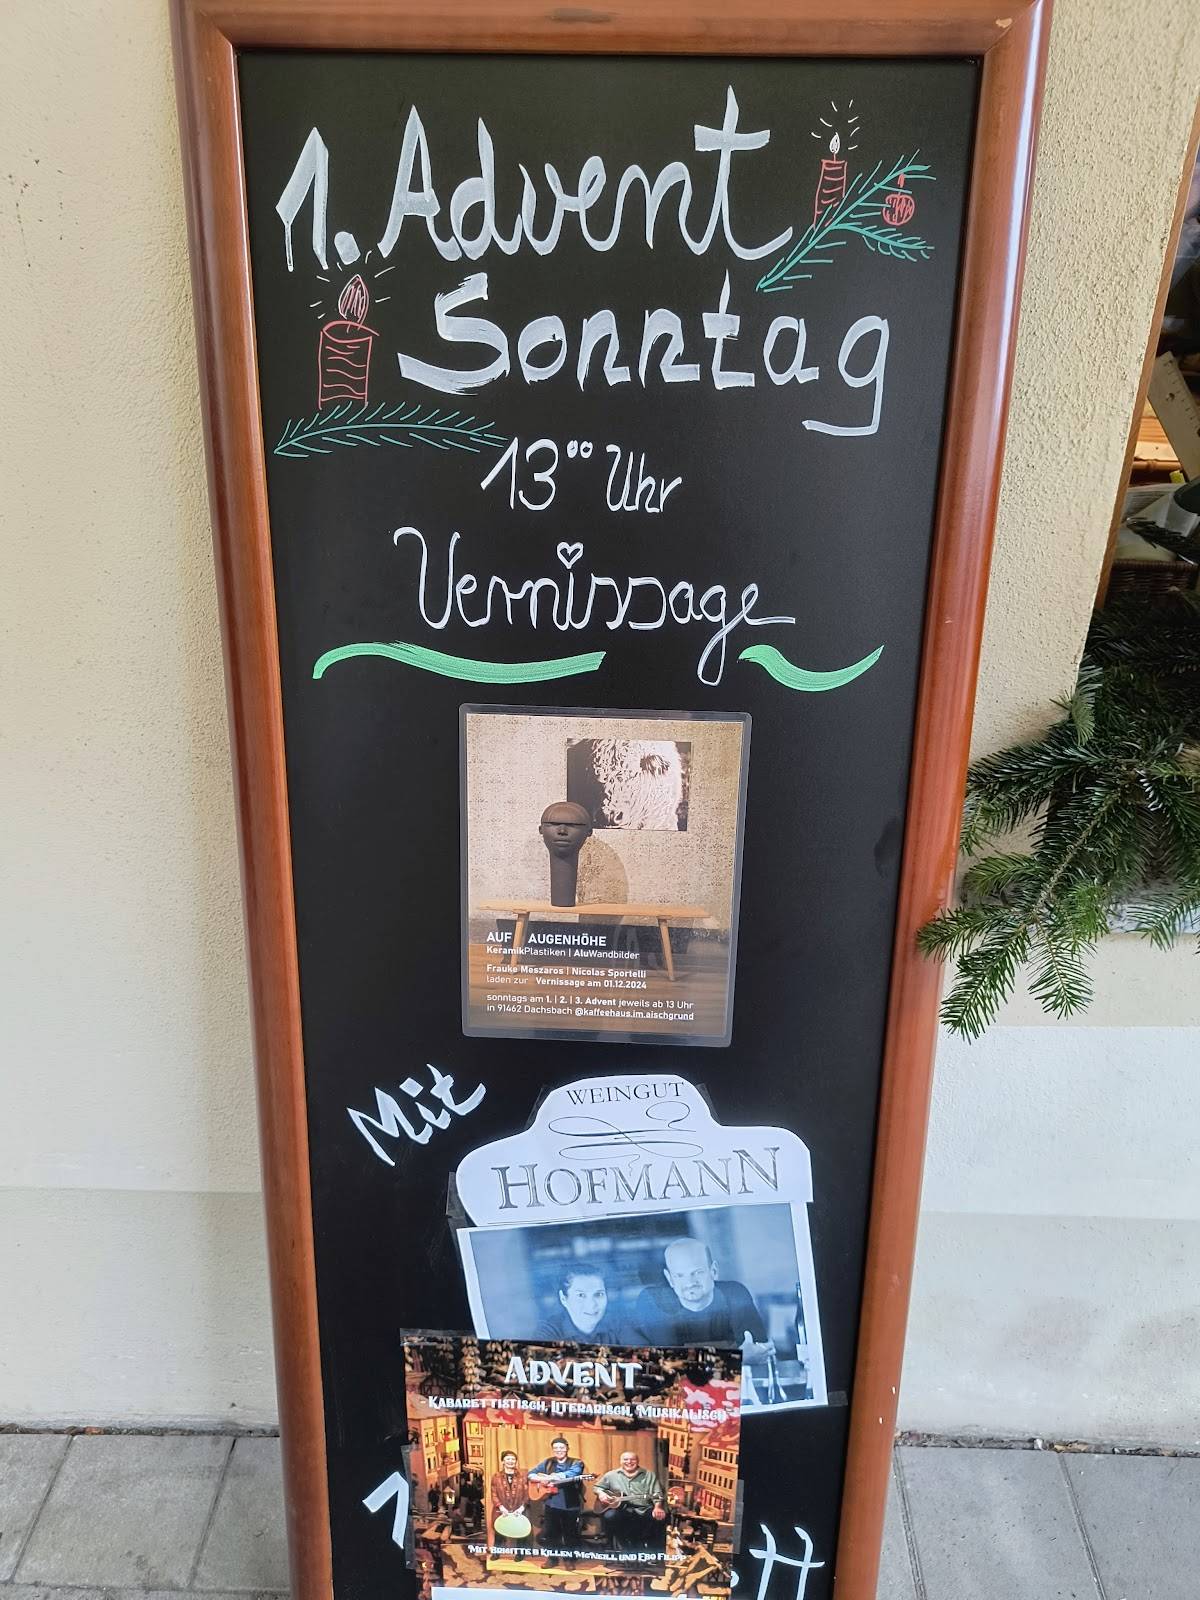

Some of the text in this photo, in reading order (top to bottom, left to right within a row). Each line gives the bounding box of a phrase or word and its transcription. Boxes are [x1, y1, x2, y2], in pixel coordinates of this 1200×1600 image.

[275, 85, 793, 271] 1. Advent
[397, 269, 890, 436] Sonntag
[605, 444, 683, 513] Uhr
[393, 527, 796, 687] Vernissage
[486, 932, 607, 947] AUF AUGENHÖHE
[486, 945, 566, 957] KeramikPlastiken
[573, 948, 640, 959] AluWandbilder
[486, 964, 518, 973] Frauke
[520, 965, 564, 975] Meszaros
[571, 967, 606, 977] Nicolas
[607, 968, 647, 979] Sportelli
[486, 975, 511, 984] laden
[513, 977, 528, 985] zur
[535, 977, 586, 988] Vernissage
[603, 979, 647, 990] 01.12.2024
[486, 994, 528, 1004] sonntags
[529, 995, 544, 1003] am
[545, 995, 553, 1003] 1.
[559, 995, 568, 1004] 2.
[574, 996, 583, 1005] 3.
[584, 997, 616, 1006] Advent
[617, 998, 650, 1008] jeweils
[652, 1000, 663, 1008] ab
[665, 1000, 675, 1009] 13
[676, 1000, 694, 1009] Uhr
[486, 1004, 694, 1021] in 91462 Dachsbach @kaffeehaus.im.aischgrund
[566, 1081, 685, 1107] WEINGUT
[347, 1063, 486, 1166] Mit
[491, 1146, 782, 1211] HOFMANN
[503, 1356, 643, 1389] ADVENT
